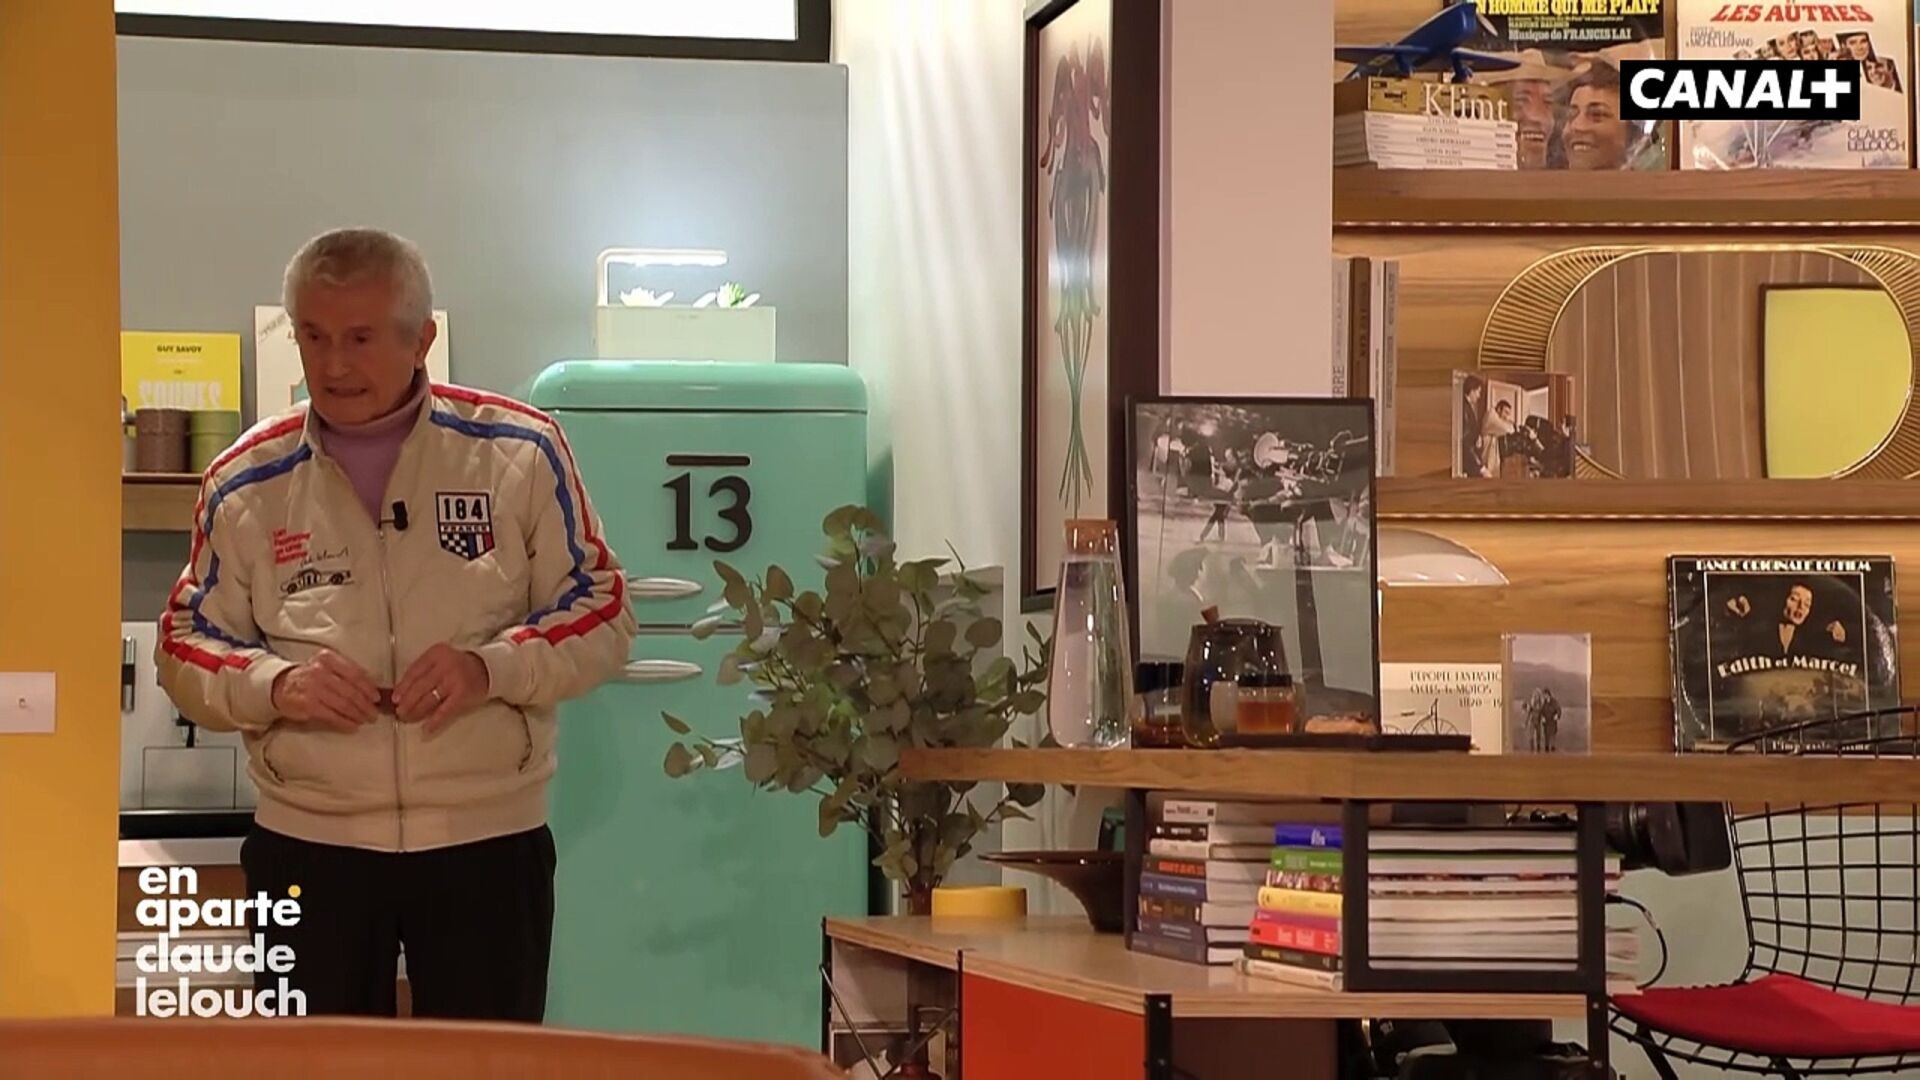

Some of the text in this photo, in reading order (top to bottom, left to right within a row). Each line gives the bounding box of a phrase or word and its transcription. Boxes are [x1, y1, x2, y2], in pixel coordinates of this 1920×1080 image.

[1489, 0, 1549, 14] HOMME
[1551, 0, 1579, 16] QUI
[1581, 0, 1608, 14] ME
[1710, 4, 1874, 22] LES AUTRES
[1509, 28, 1632, 41] Musique de FRANCIS LAI
[1423, 83, 1508, 121] Klimt
[1848, 128, 1897, 140] CLAUDE
[1848, 139, 1905, 151] LELOUCH
[156, 345, 202, 353] GUY SAVOY
[444, 497, 483, 520] 184
[662, 472, 753, 553] 13
[1696, 560, 1739, 571] BANDE
[1742, 560, 1812, 571] ORIGINALE
[1837, 561, 1871, 572] FILM
[1717, 655, 1858, 678] Edith et Marcel
